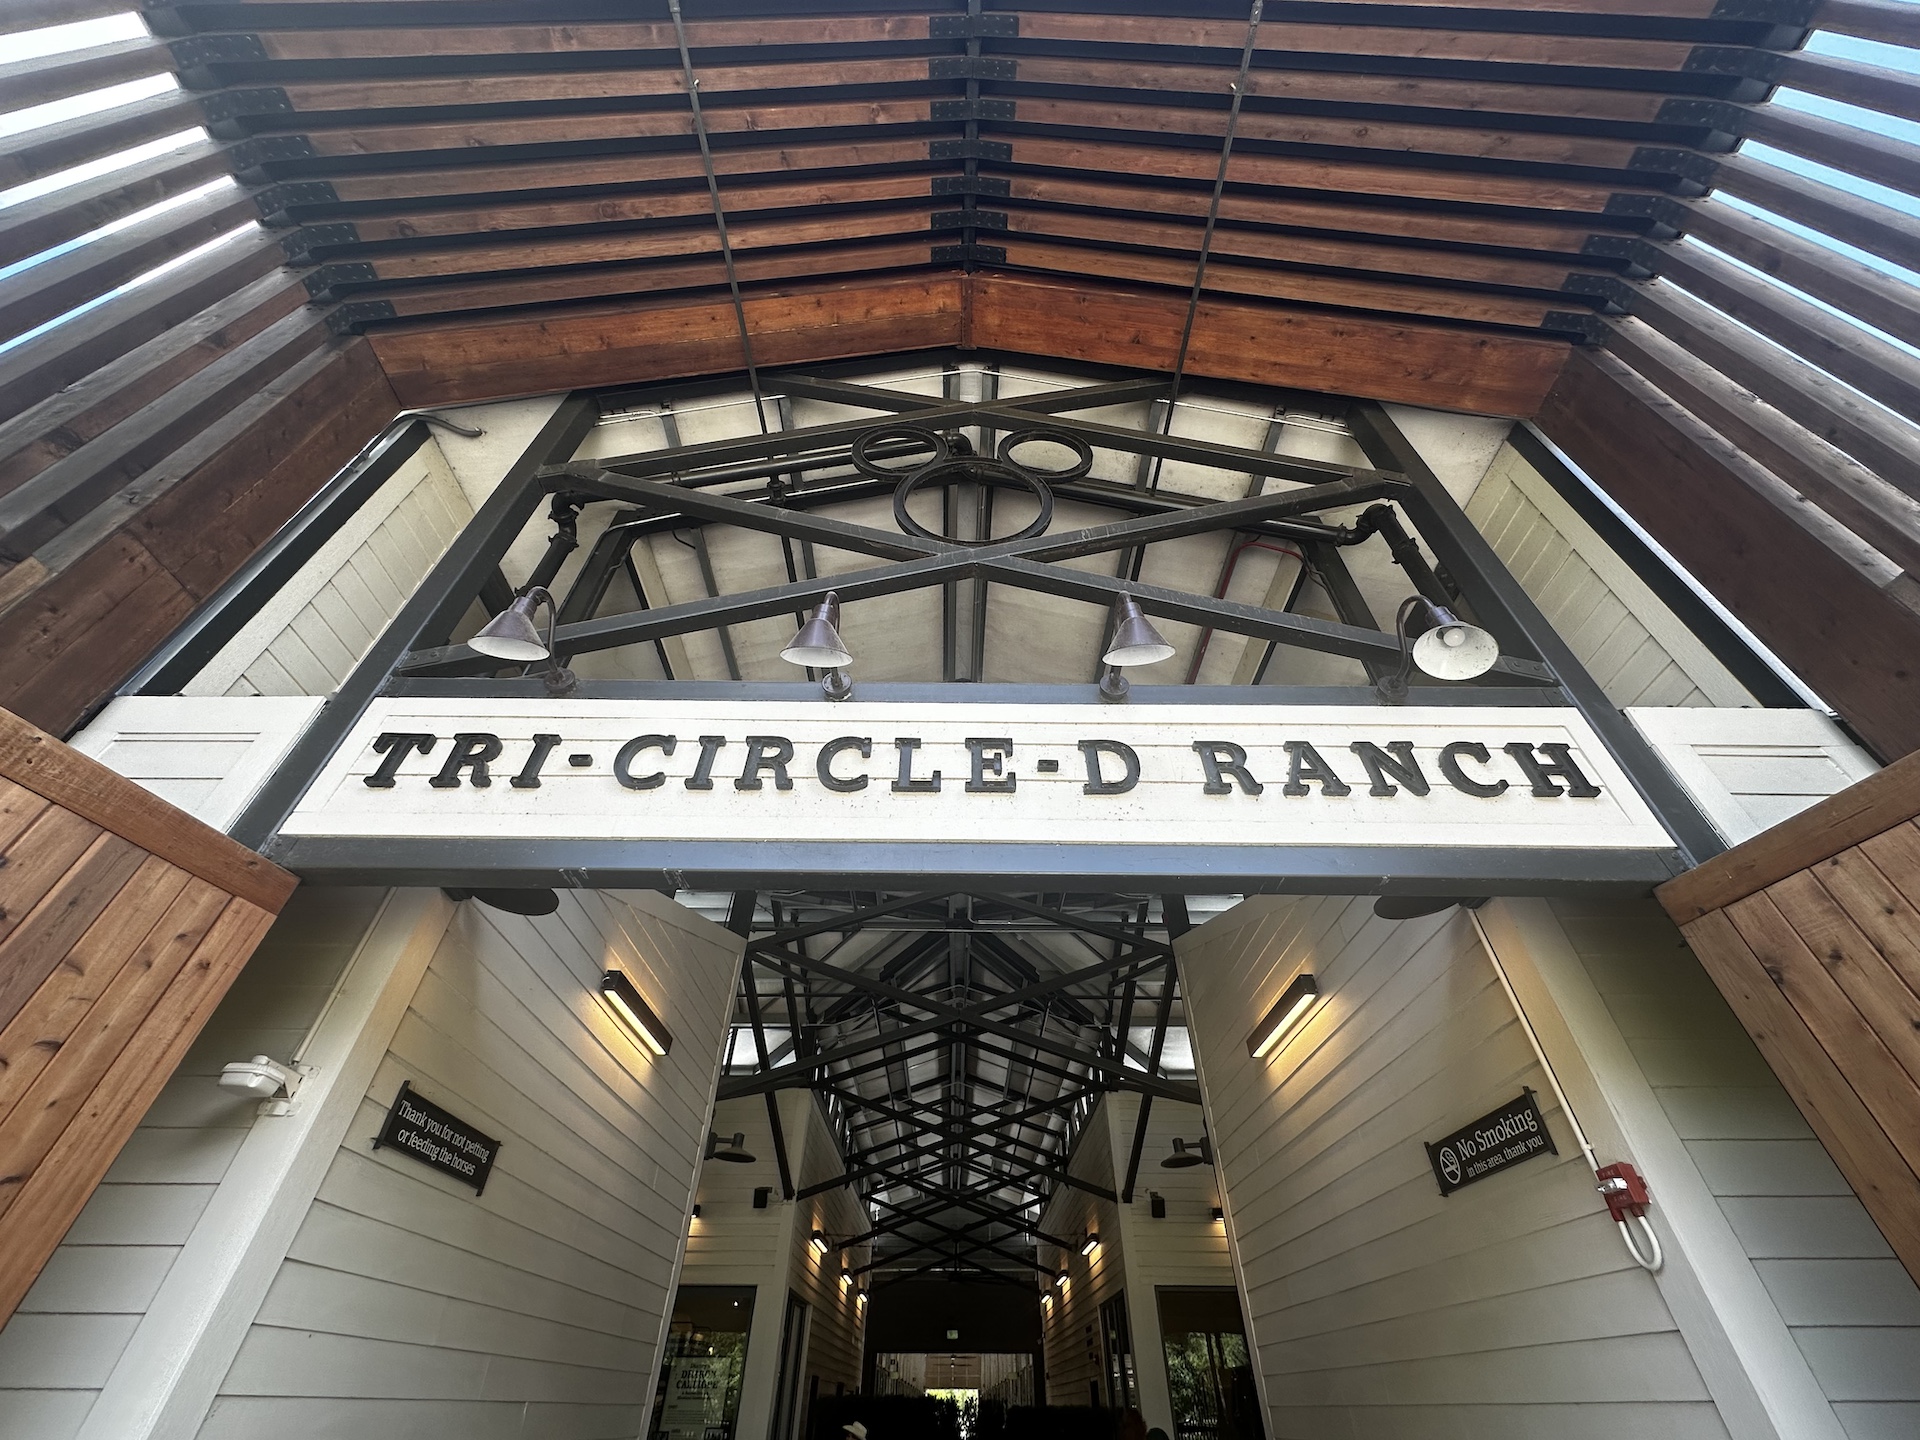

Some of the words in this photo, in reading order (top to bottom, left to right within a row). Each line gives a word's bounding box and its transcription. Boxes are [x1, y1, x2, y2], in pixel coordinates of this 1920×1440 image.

[362, 732, 1141, 796] TRI-CIRCLE-D
[1192, 740, 1602, 798] RANCH
[398, 1100, 428, 1128] Thank
[424, 1118, 443, 1136] you
[440, 1124, 455, 1142] for
[451, 1132, 467, 1149] not
[462, 1138, 490, 1164] petting
[398, 1129, 410, 1143] or
[407, 1131, 440, 1161] feeding
[438, 1146, 453, 1165] the
[450, 1152, 477, 1176] horses
[1456, 1138, 1477, 1162] No
[1474, 1108, 1538, 1153] Smoking
[1466, 1165, 1475, 1178] in
[1473, 1159, 1489, 1175] this
[1488, 1153, 1507, 1170] area,
[1503, 1140, 1529, 1160] thank
[1526, 1134, 1544, 1153] you
